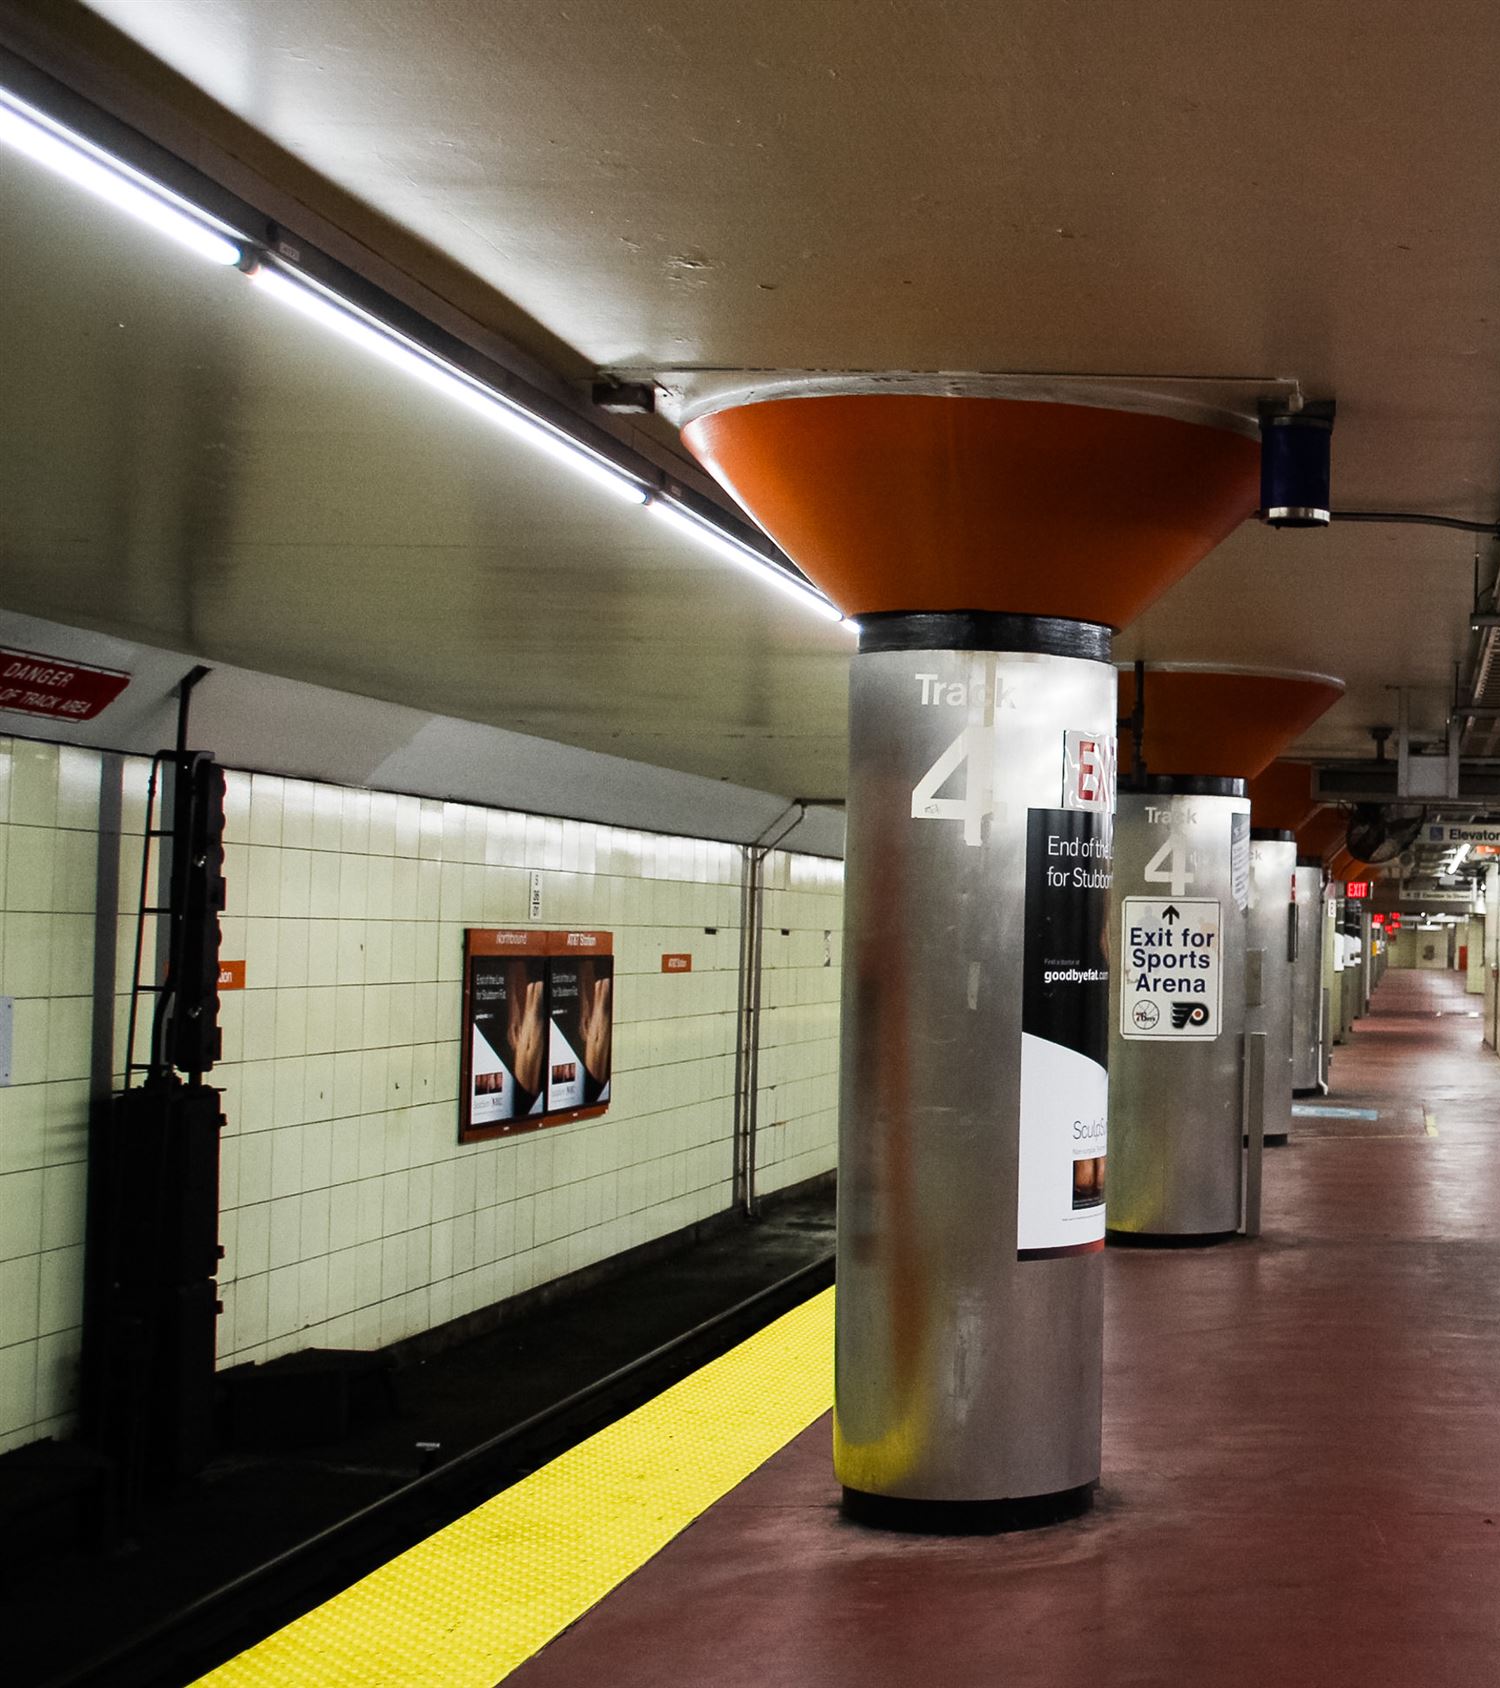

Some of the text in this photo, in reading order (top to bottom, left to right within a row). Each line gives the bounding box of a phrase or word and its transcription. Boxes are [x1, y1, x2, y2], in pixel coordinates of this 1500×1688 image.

[3, 662, 75, 687] DANGER
[19, 691, 62, 709] TRACK
[58, 700, 92, 714] AREA
[911, 727, 998, 846] 4
[1047, 835, 1079, 857] End
[1081, 837, 1095, 858] of
[1450, 829, 1500, 842] Elevator
[1144, 833, 1194, 896] 4
[1047, 866, 1070, 887] for
[1347, 882, 1367, 898] EXIT
[1130, 927, 1215, 947] Exit for
[1132, 948, 1211, 973] Sports
[1135, 973, 1206, 993] Arena
